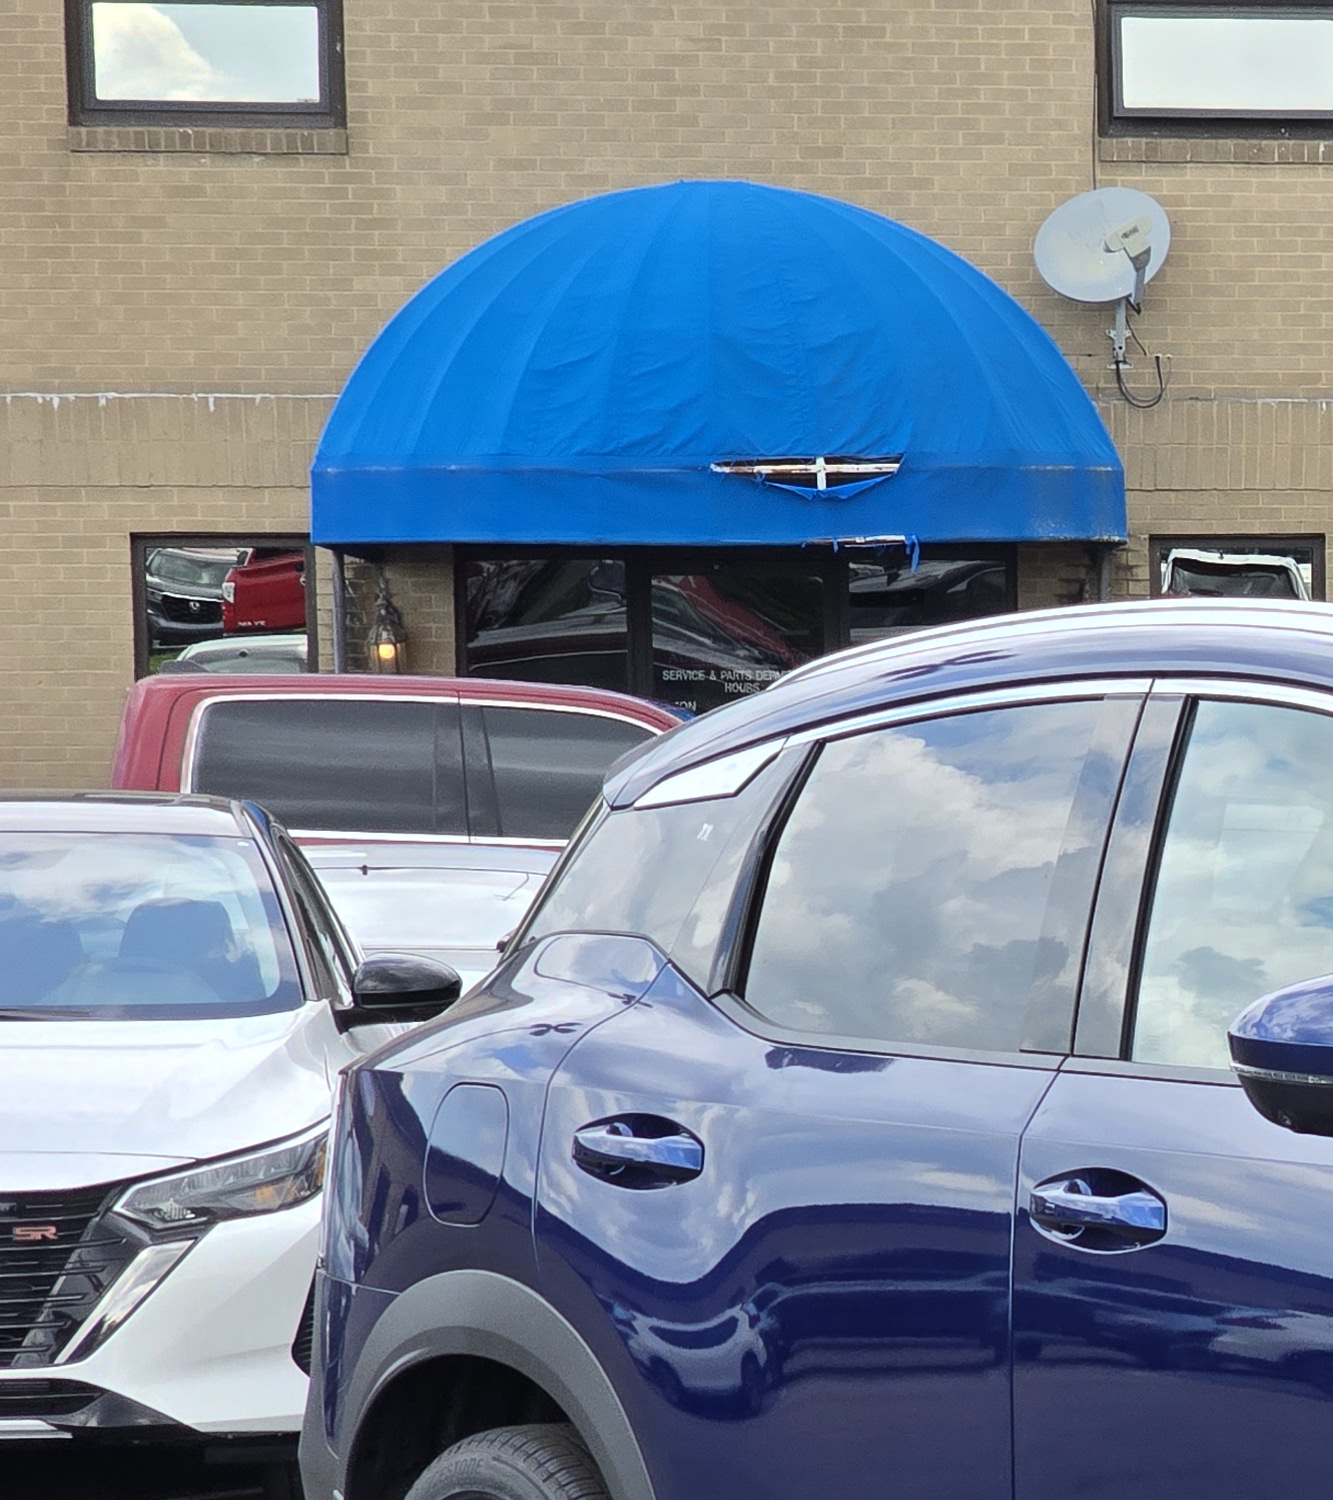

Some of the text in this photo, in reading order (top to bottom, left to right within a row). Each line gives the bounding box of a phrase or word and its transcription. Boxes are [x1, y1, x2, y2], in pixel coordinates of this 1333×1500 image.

[662, 670, 705, 681] SERVICE
[709, 670, 717, 681] &
[720, 669, 753, 680] PARTS
[724, 682, 760, 693] HOURS
[13, 1226, 59, 1240] SR
